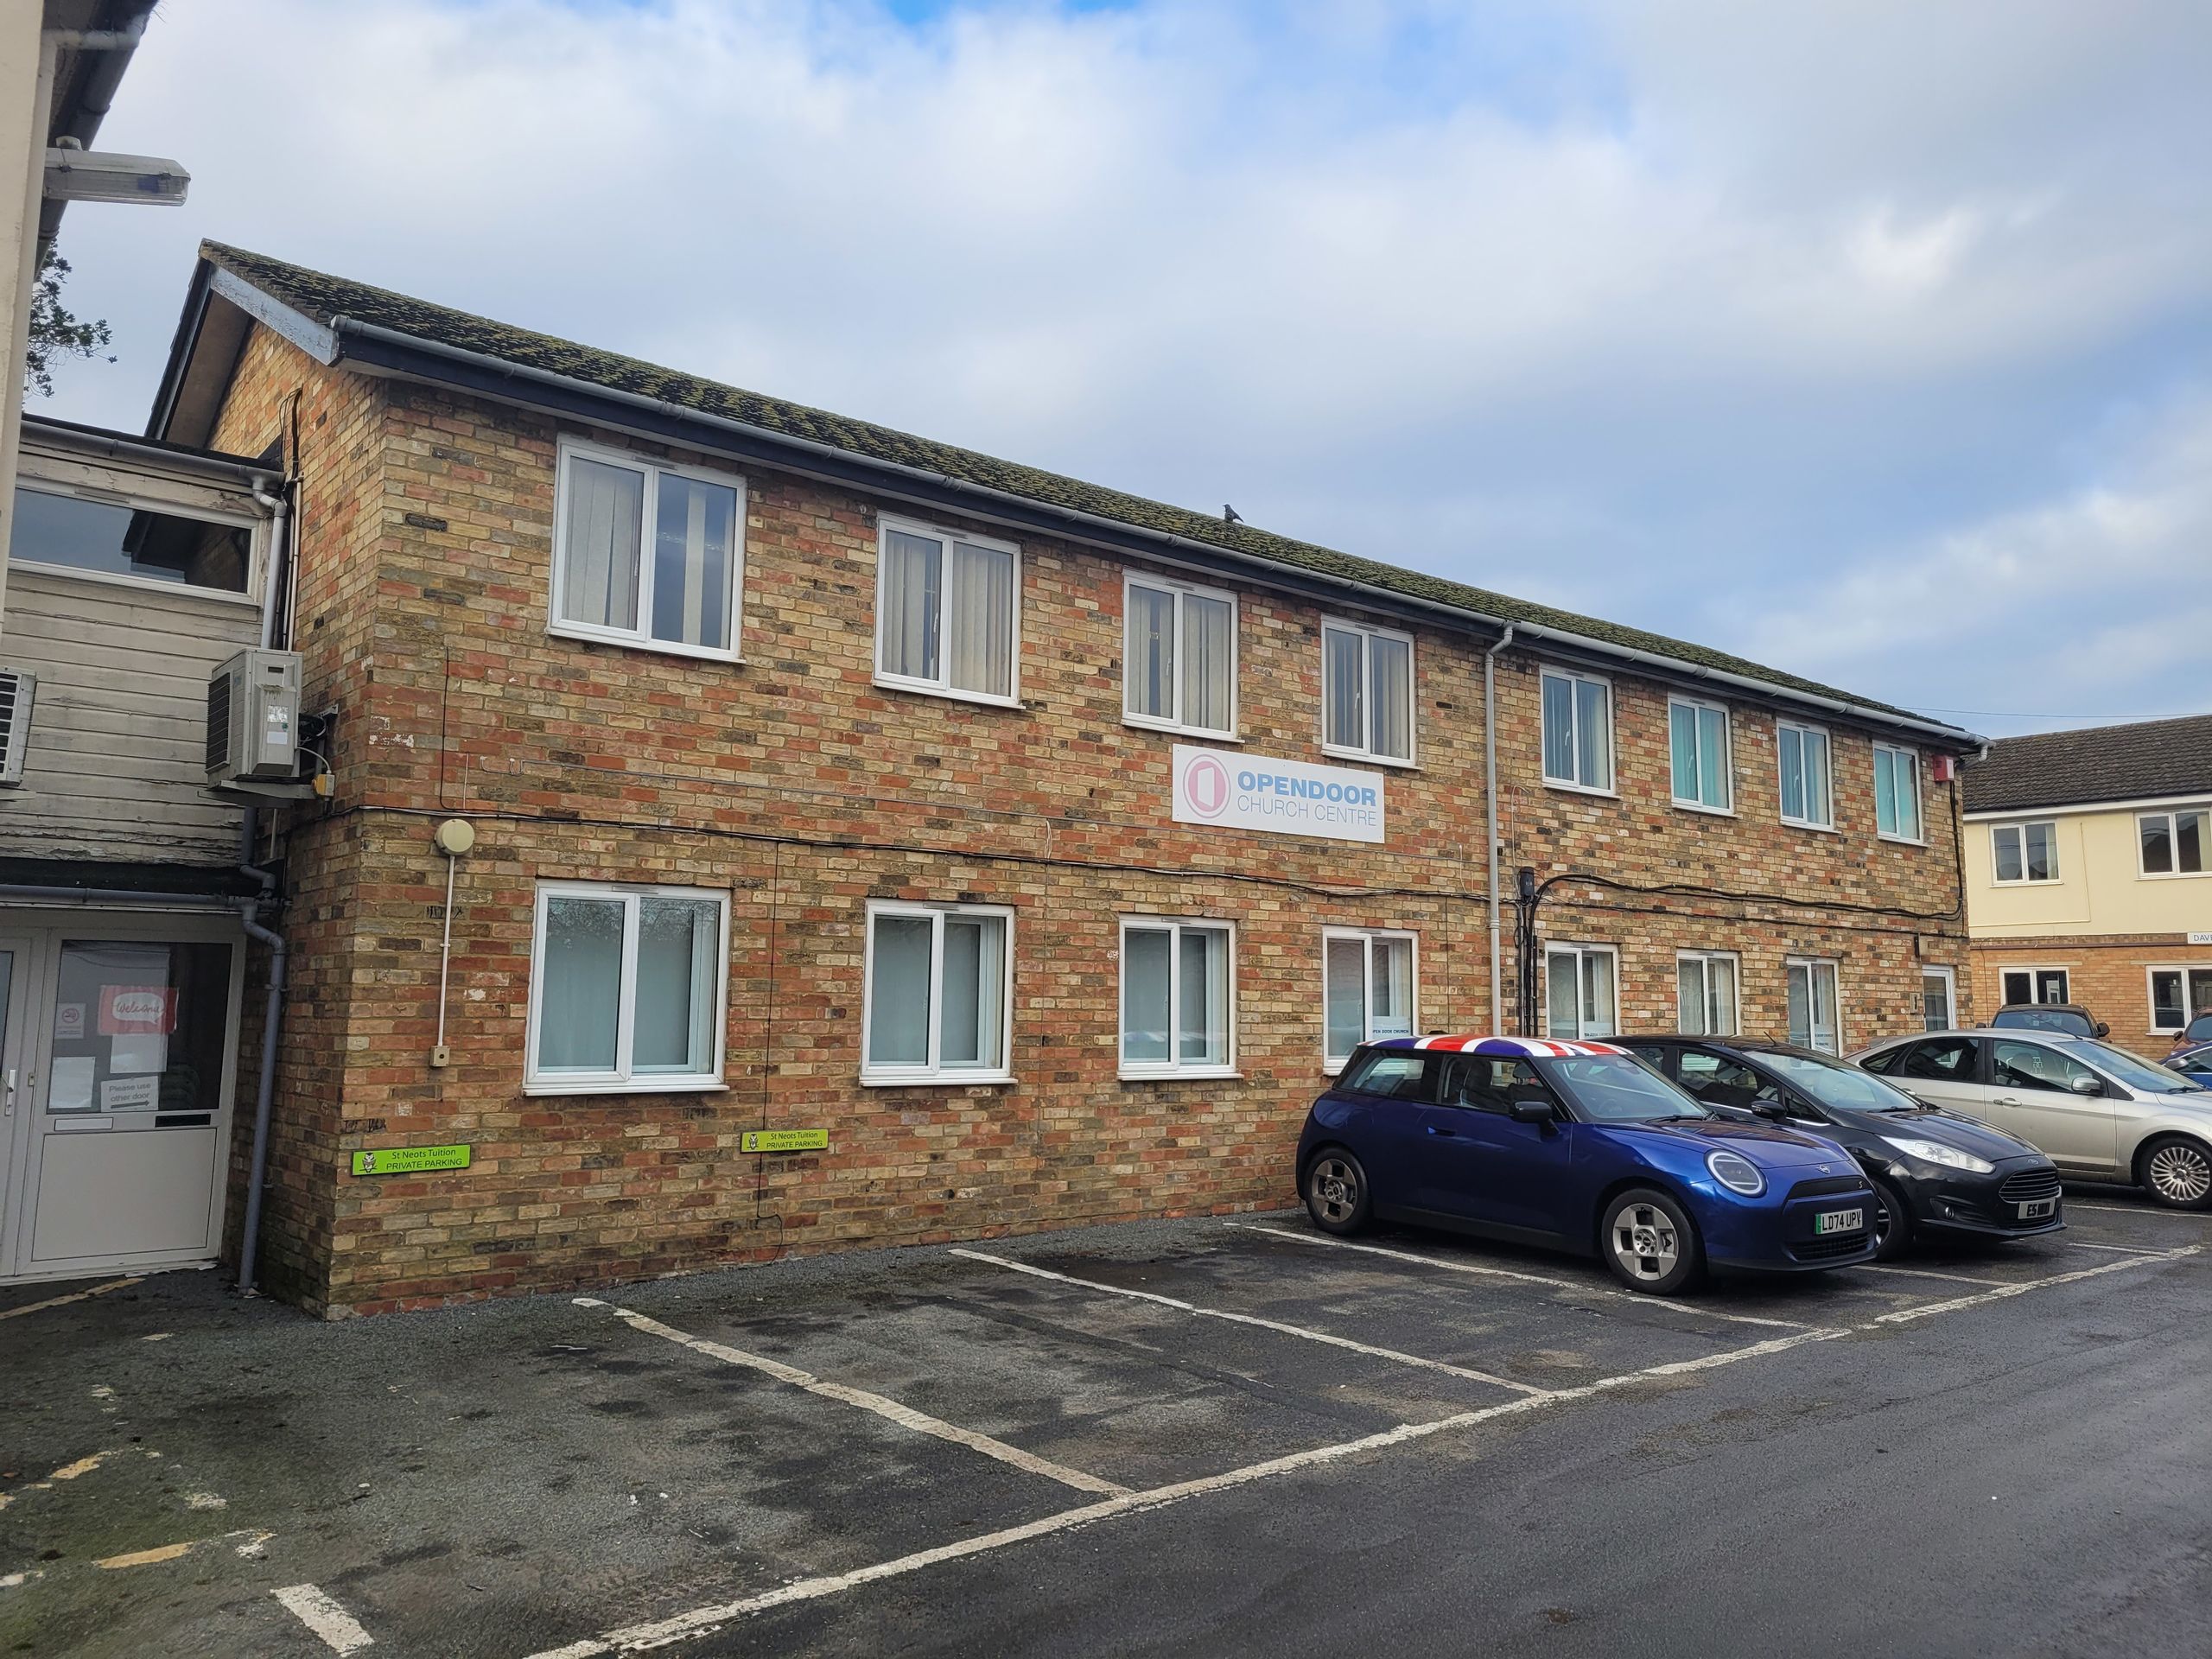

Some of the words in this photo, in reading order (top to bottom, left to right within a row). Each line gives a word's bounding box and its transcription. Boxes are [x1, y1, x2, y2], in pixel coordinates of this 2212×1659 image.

[1237, 771, 1376, 807] OPENDOOR
[1237, 795, 1309, 818] CHURCH
[1314, 804, 1376, 827] CENTRE
[112, 1001, 162, 1014] Welcome
[391, 1151, 400, 1160] St
[402, 1150, 427, 1159] Neots
[429, 1148, 456, 1157] Tuition
[386, 1160, 423, 1170] PRIVATE
[424, 1158, 462, 1167] PARKING
[1822, 1213, 1845, 1231] LD74
[1846, 1211, 1862, 1227] UPV
